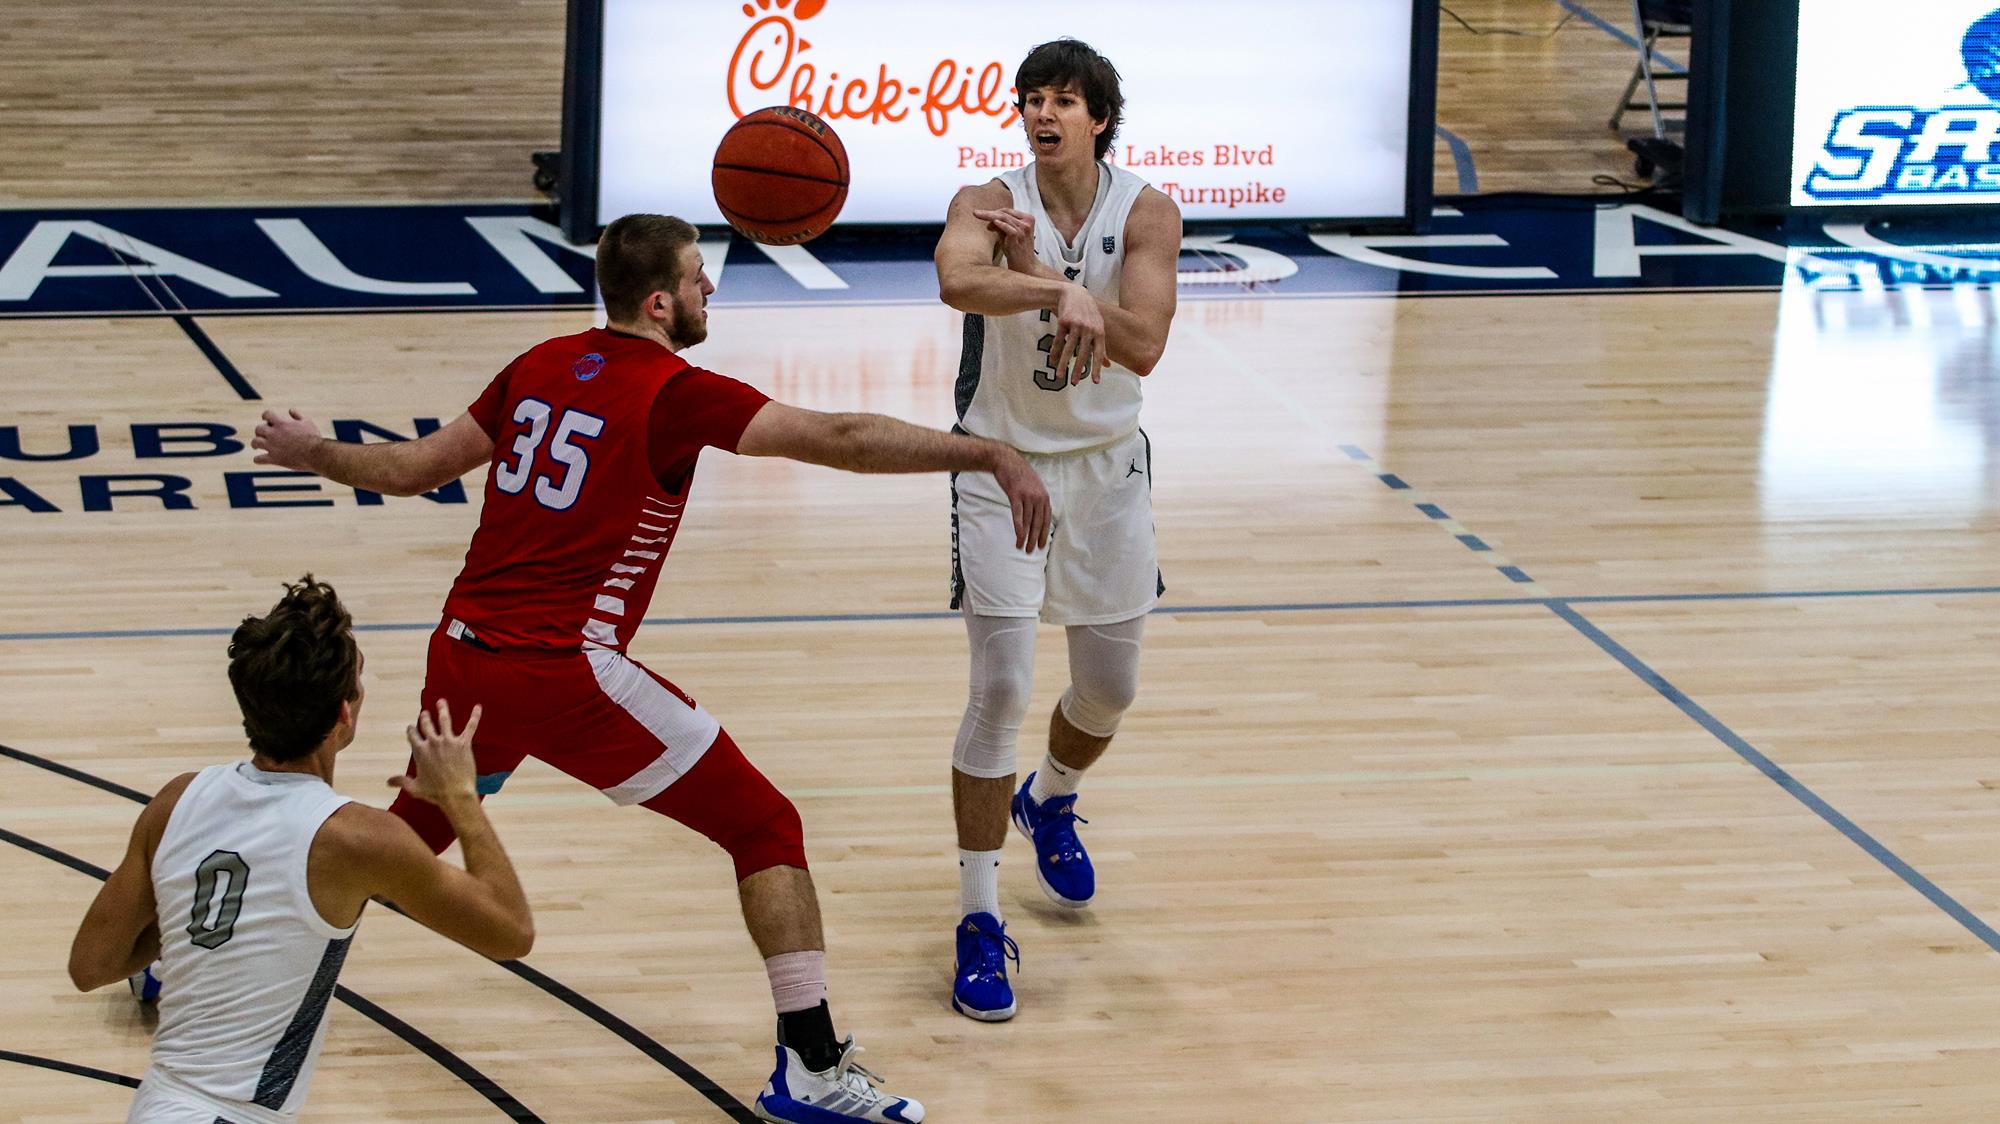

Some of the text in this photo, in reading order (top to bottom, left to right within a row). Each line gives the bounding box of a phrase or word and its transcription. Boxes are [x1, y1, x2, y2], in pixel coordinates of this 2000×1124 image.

[957, 146, 1024, 168] Palm
[1126, 144, 1204, 167] Lakes
[1214, 144, 1274, 166] Blvd
[1162, 182, 1286, 208] Turnpike
[1033, 333, 1092, 392] 3
[496, 397, 605, 513] 35
[186, 848, 251, 950] 0
